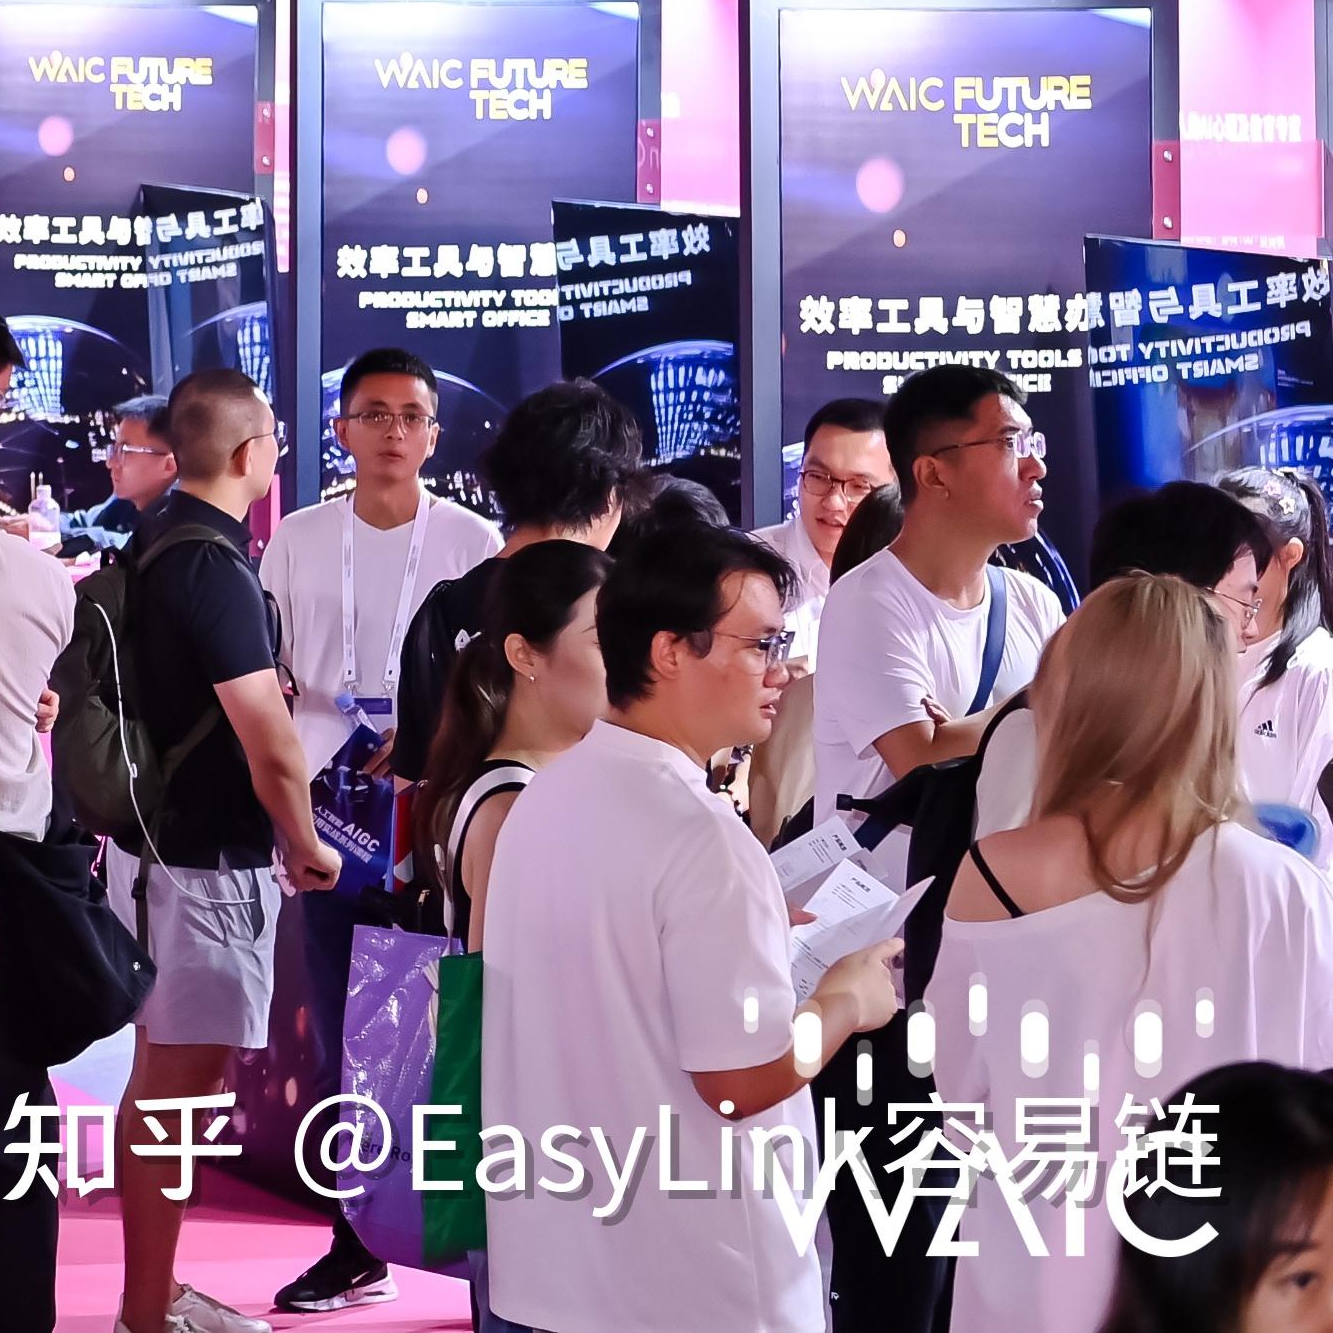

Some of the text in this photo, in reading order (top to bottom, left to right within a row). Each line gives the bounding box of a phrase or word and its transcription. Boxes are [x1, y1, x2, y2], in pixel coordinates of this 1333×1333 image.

[28, 56, 212, 85] WAIC FUTURE
[374, 58, 588, 89] WAIC FUTURE
[110, 84, 182, 111] TECH
[469, 88, 553, 121] TECH
[841, 75, 1092, 111] WAIC FUTURE
[953, 113, 1050, 148] TECH
[14, 254, 142, 272] PRODUCTIVITY
[55, 273, 117, 288] SMART
[359, 290, 506, 309] PRODUCTIVITY
[406, 309, 550, 329] SMART OFFICE
[826, 348, 1083, 370] PRODUCTIVITY TOOLS
[342, 823, 380, 852] AIGC
